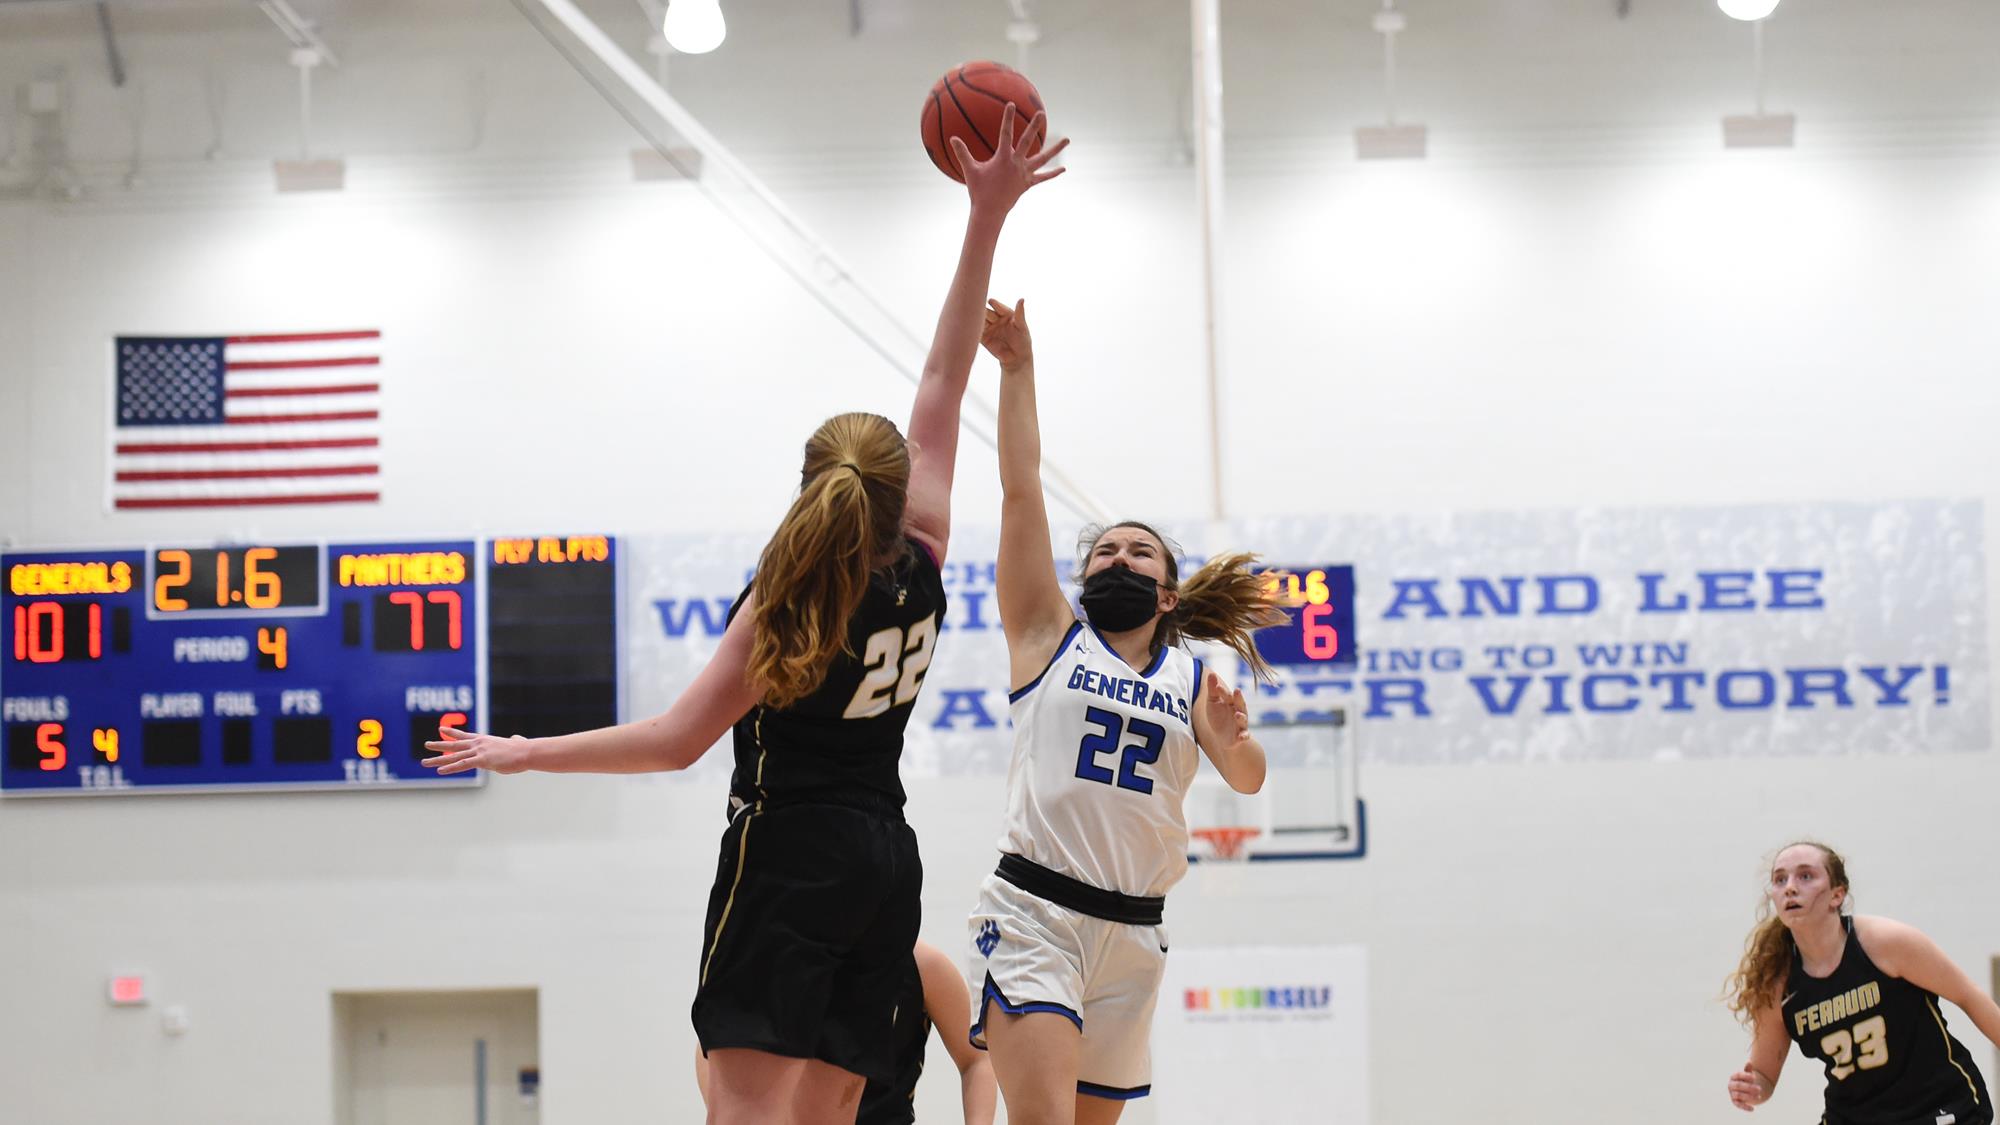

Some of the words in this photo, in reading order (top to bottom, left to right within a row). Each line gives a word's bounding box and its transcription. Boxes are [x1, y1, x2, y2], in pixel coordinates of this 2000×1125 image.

[10, 561, 131, 595] GENERALS
[155, 547, 281, 612] 21.6
[339, 552, 465, 587] PANTHERS
[1377, 575, 1599, 620] AND
[1636, 569, 1826, 614] LEE
[14, 601, 102, 663] 101
[389, 590, 462, 650] 77
[1302, 602, 1338, 660] 6
[173, 636, 249, 663] PERIOD
[257, 627, 287, 669] 4
[842, 609, 938, 719] 22
[1482, 645, 1555, 670] TO
[1576, 641, 1688, 668] WIN
[3, 695, 69, 722] FOULS
[140, 692, 204, 718] PLAYER
[213, 691, 258, 716] FOUL
[280, 690, 322, 715] PTS
[405, 686, 473, 711] FOULS
[1067, 664, 1189, 726] GENERALS
[1467, 664, 1950, 716] VICTORY!
[36, 723, 66, 771] 5
[92, 728, 119, 762] 4
[356, 719, 383, 759] 2
[1075, 705, 1167, 796] 22
[1184, 987, 1213, 1012] BE
[1216, 985, 1331, 1010] YOURSELF
[1820, 1014, 1889, 1081] 23
